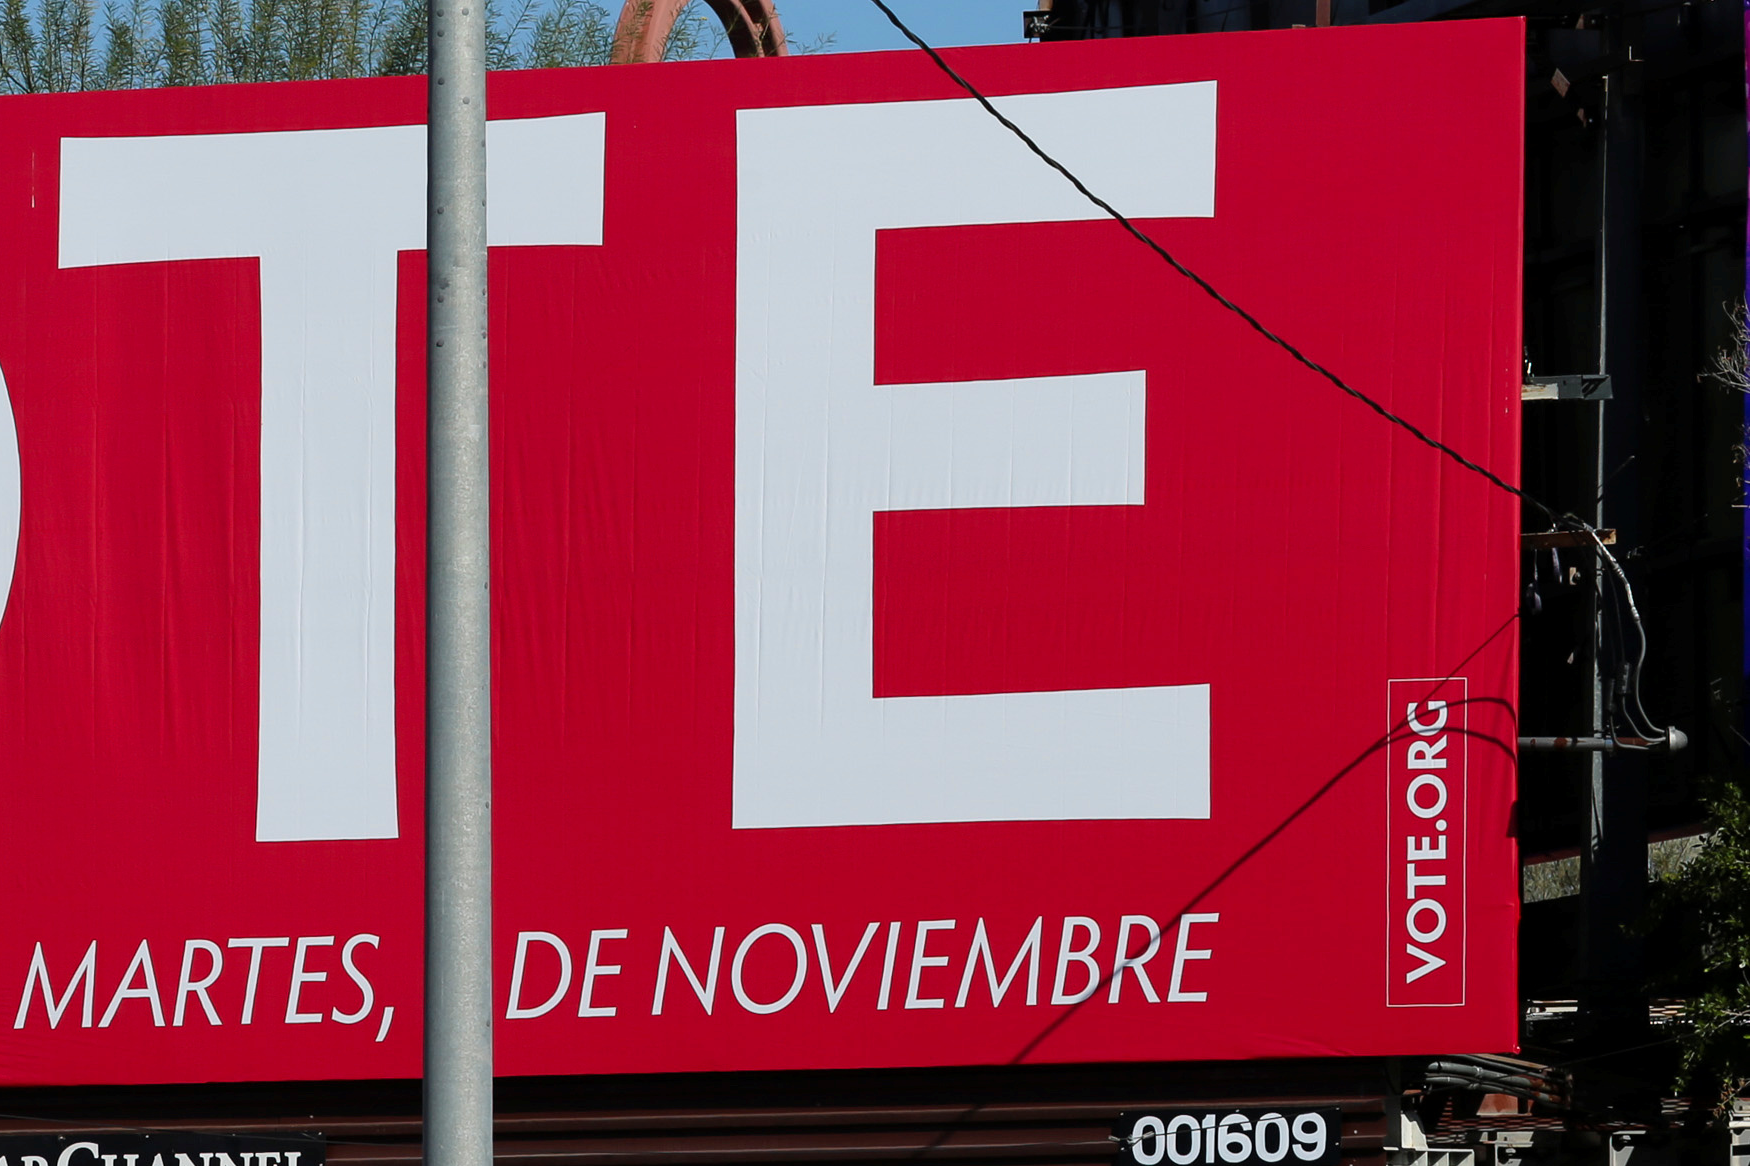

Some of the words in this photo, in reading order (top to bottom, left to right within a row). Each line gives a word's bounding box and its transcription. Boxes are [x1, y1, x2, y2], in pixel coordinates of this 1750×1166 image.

[1405, 699, 1448, 985] VOTE.ORG
[12, 932, 395, 1043] MARTES,
[504, 928, 630, 1021] DE
[650, 911, 1221, 1017] NOVIEMBRE
[1126, 1111, 1328, 1166] 001609
